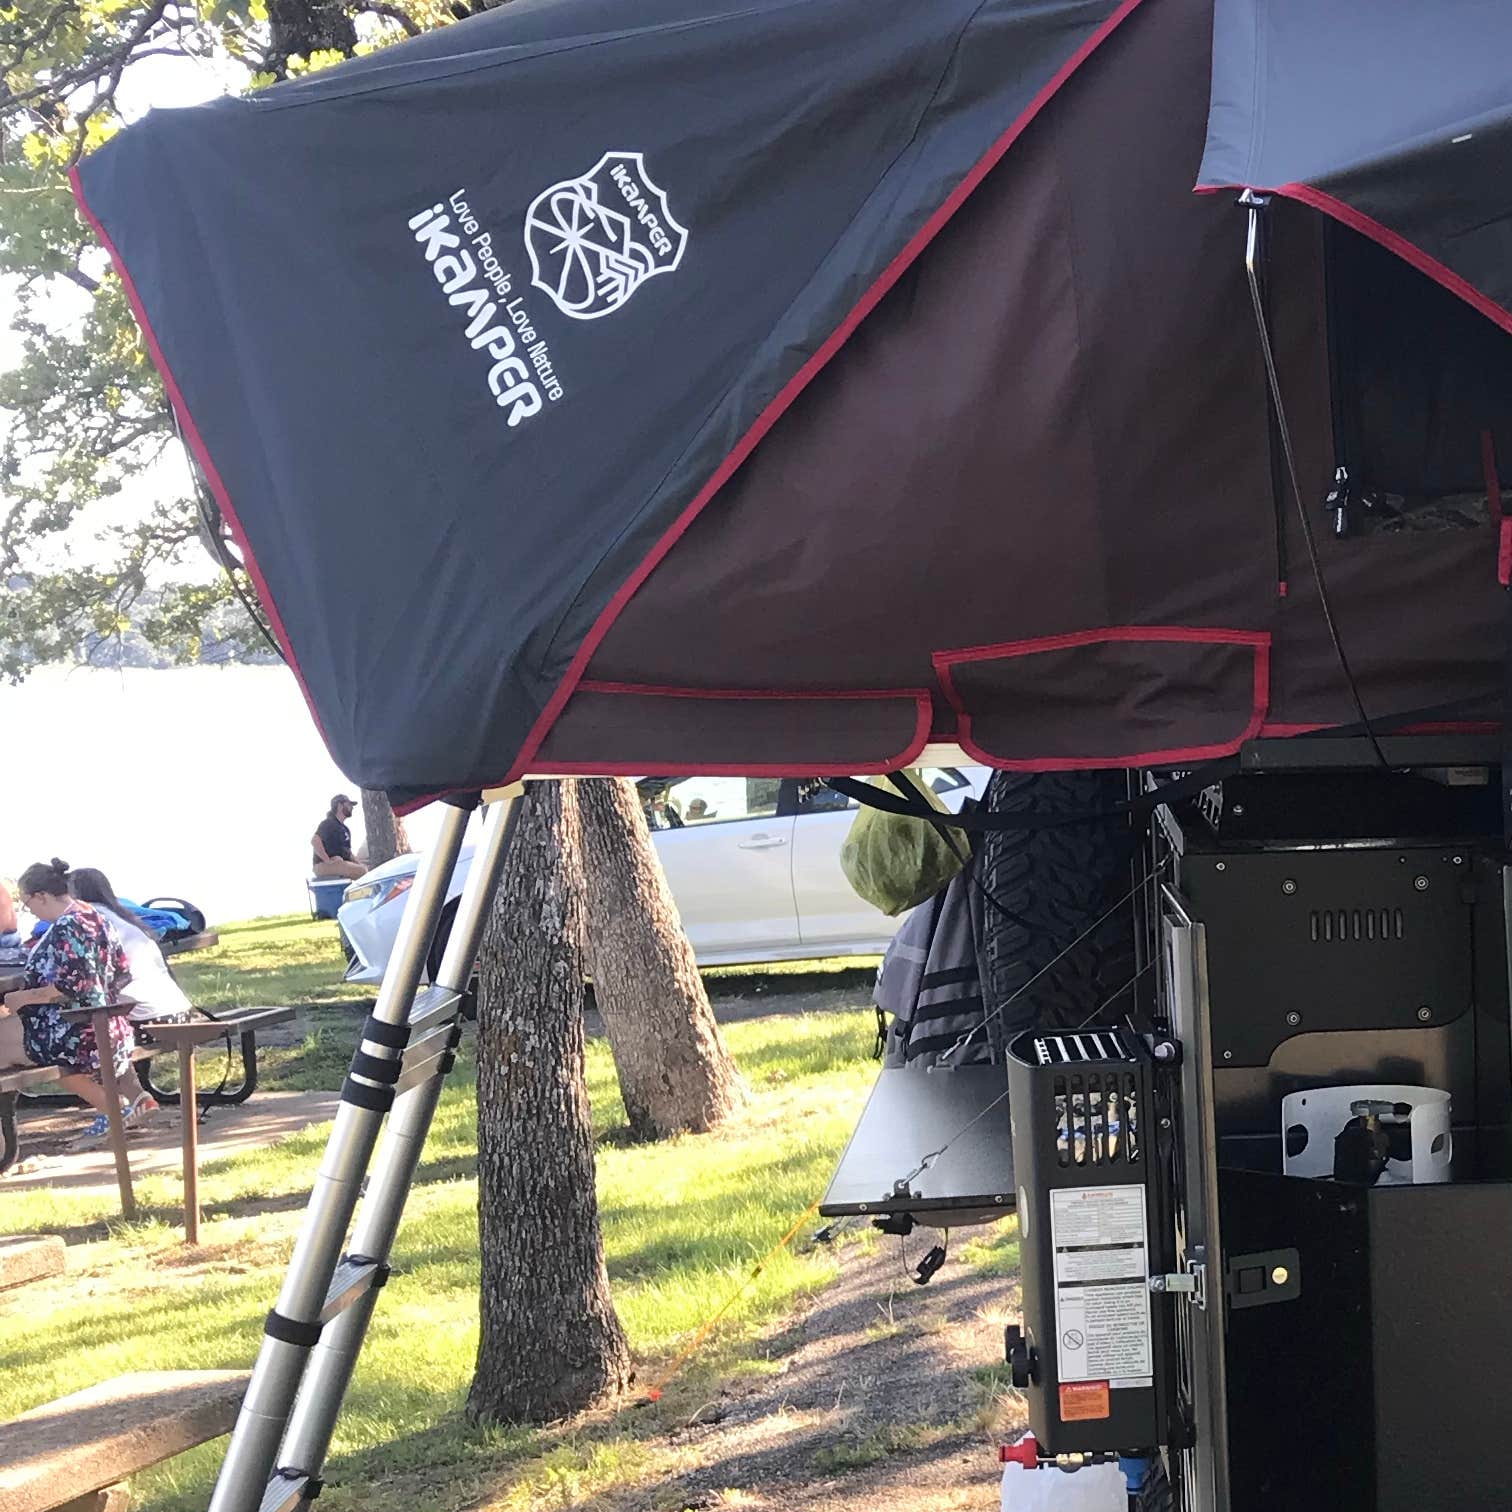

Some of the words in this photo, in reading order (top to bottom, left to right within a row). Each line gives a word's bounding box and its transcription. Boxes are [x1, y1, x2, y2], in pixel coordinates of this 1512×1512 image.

[448, 187, 480, 234] Love
[472, 228, 513, 303] People,
[506, 296, 536, 343] Love
[527, 338, 564, 401] Nature
